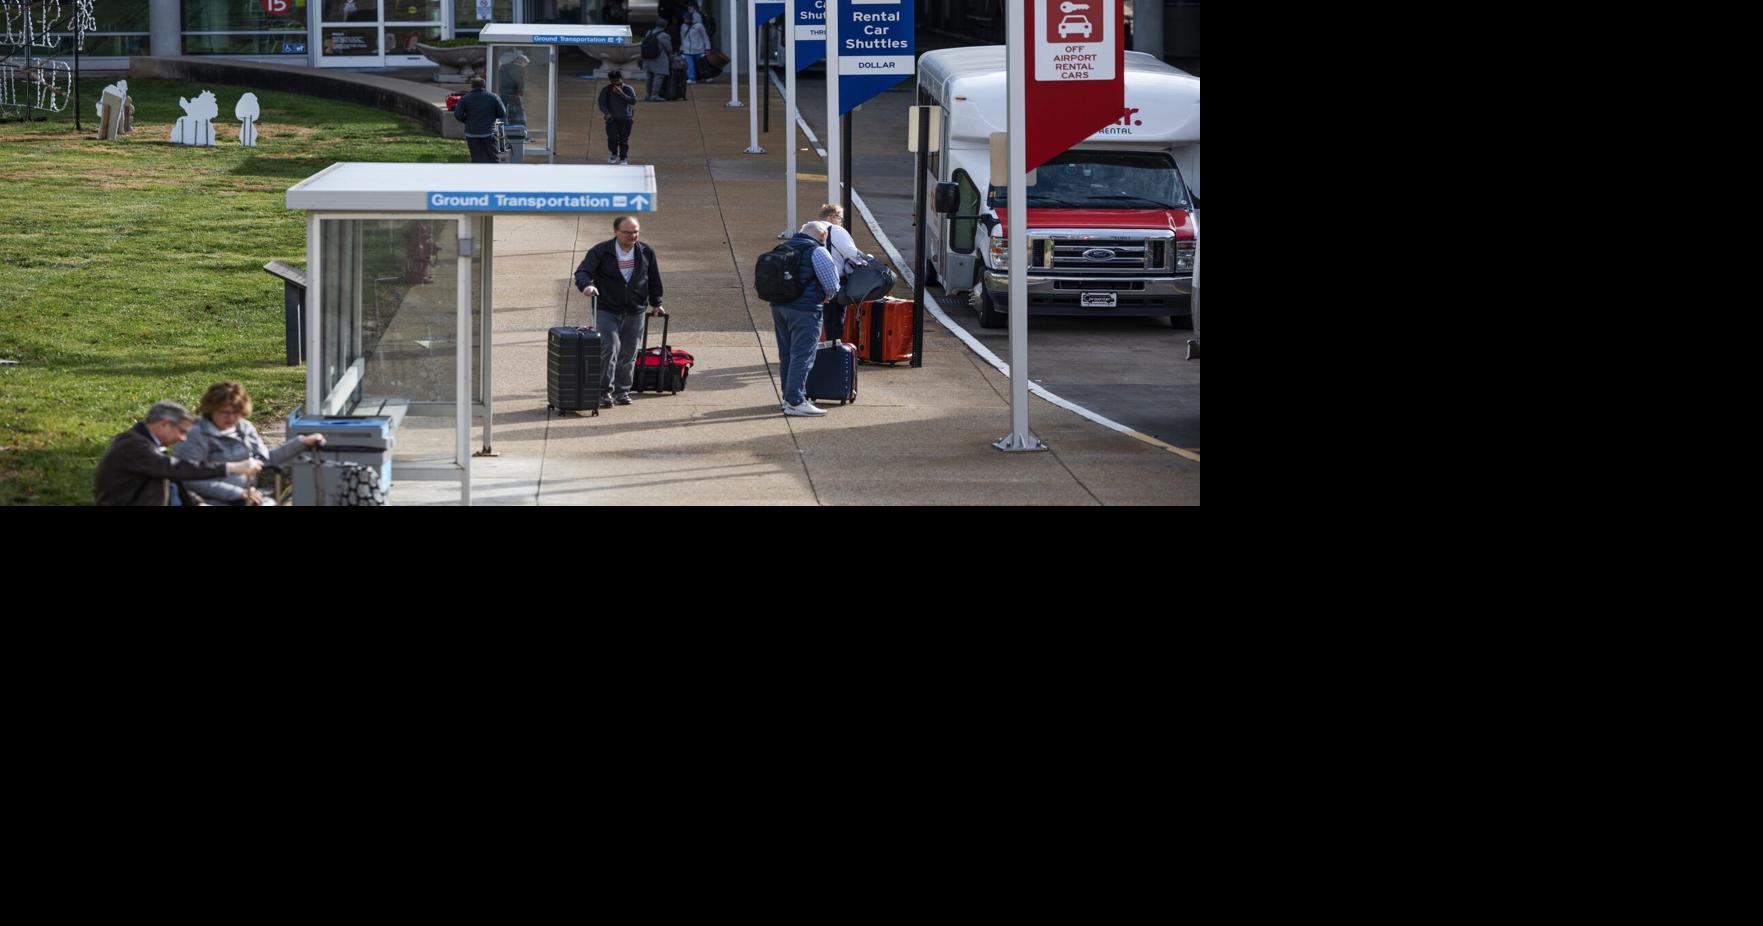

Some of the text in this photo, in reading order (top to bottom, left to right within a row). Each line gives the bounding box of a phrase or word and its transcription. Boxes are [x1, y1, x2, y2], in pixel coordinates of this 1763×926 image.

[268, 0, 287, 11] 15
[853, 11, 900, 22] Rental
[864, 25, 889, 35] Car
[560, 35, 606, 43] Transportation
[846, 38, 908, 49] Shuttles
[1065, 45, 1085, 53] OFF
[1053, 54, 1097, 62] AIRPORT
[1055, 63, 1094, 71] RENTAL
[1061, 71, 1089, 79] CARS
[1099, 127, 1133, 135] RENTAL
[431, 193, 609, 209] Ground Transportation
